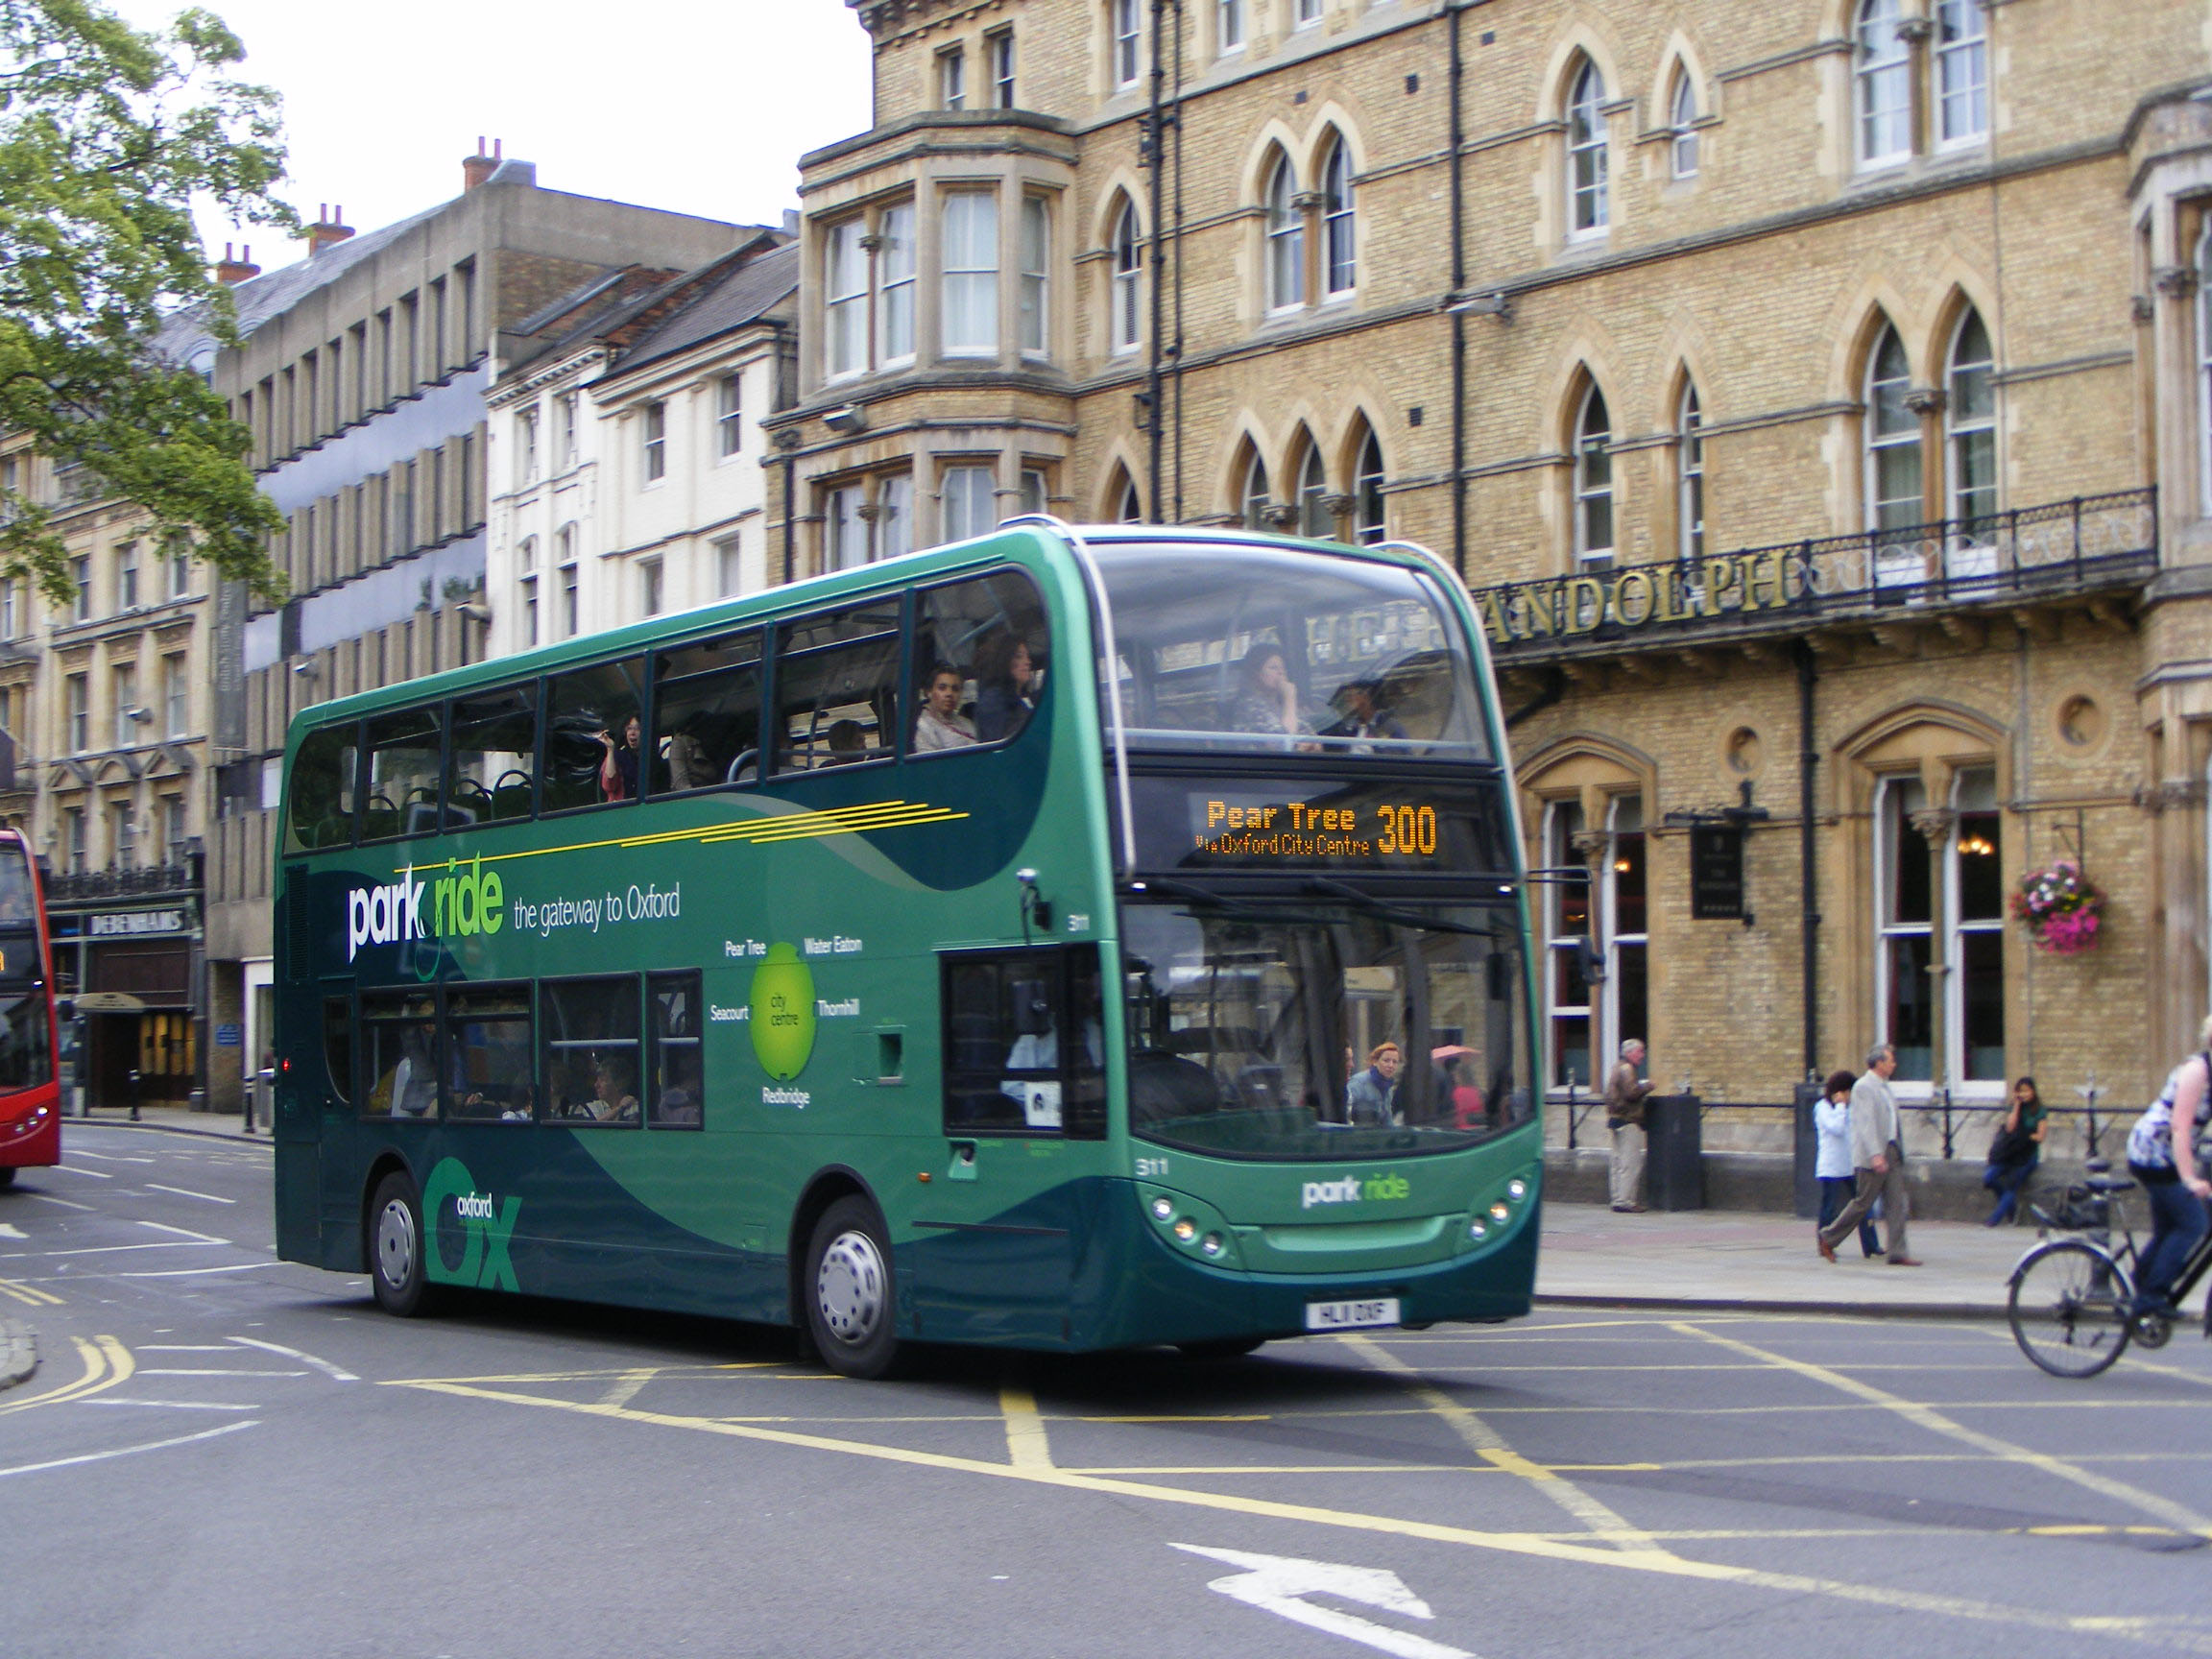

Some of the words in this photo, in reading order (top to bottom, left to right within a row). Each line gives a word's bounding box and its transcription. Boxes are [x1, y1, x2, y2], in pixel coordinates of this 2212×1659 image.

[1307, 612, 1382, 666] HE
[1208, 800, 1277, 829] Pear
[1288, 803, 1356, 830] Tree
[1377, 805, 1437, 854] 300
[1220, 832, 1278, 854] Oxford
[1282, 833, 1312, 854] City
[1316, 834, 1370, 855] Centre
[349, 861, 425, 964] park
[435, 849, 504, 937] ride
[515, 897, 537, 929] the
[541, 896, 603, 937] gateway
[606, 891, 622, 922] to
[627, 881, 681, 920] Oxford
[725, 940, 745, 957] Pear
[746, 939, 767, 956] Tree
[804, 937, 832, 955] Water
[833, 935, 862, 952] Eaton
[710, 1004, 749, 1022] Seacourt
[771, 994, 787, 1012] city
[771, 1014, 799, 1026] centre
[761, 1087, 810, 1109] Redbridge
[1302, 1174, 1361, 1209] park
[1364, 1168, 1410, 1201] ride
[457, 1190, 493, 1218] oxford
